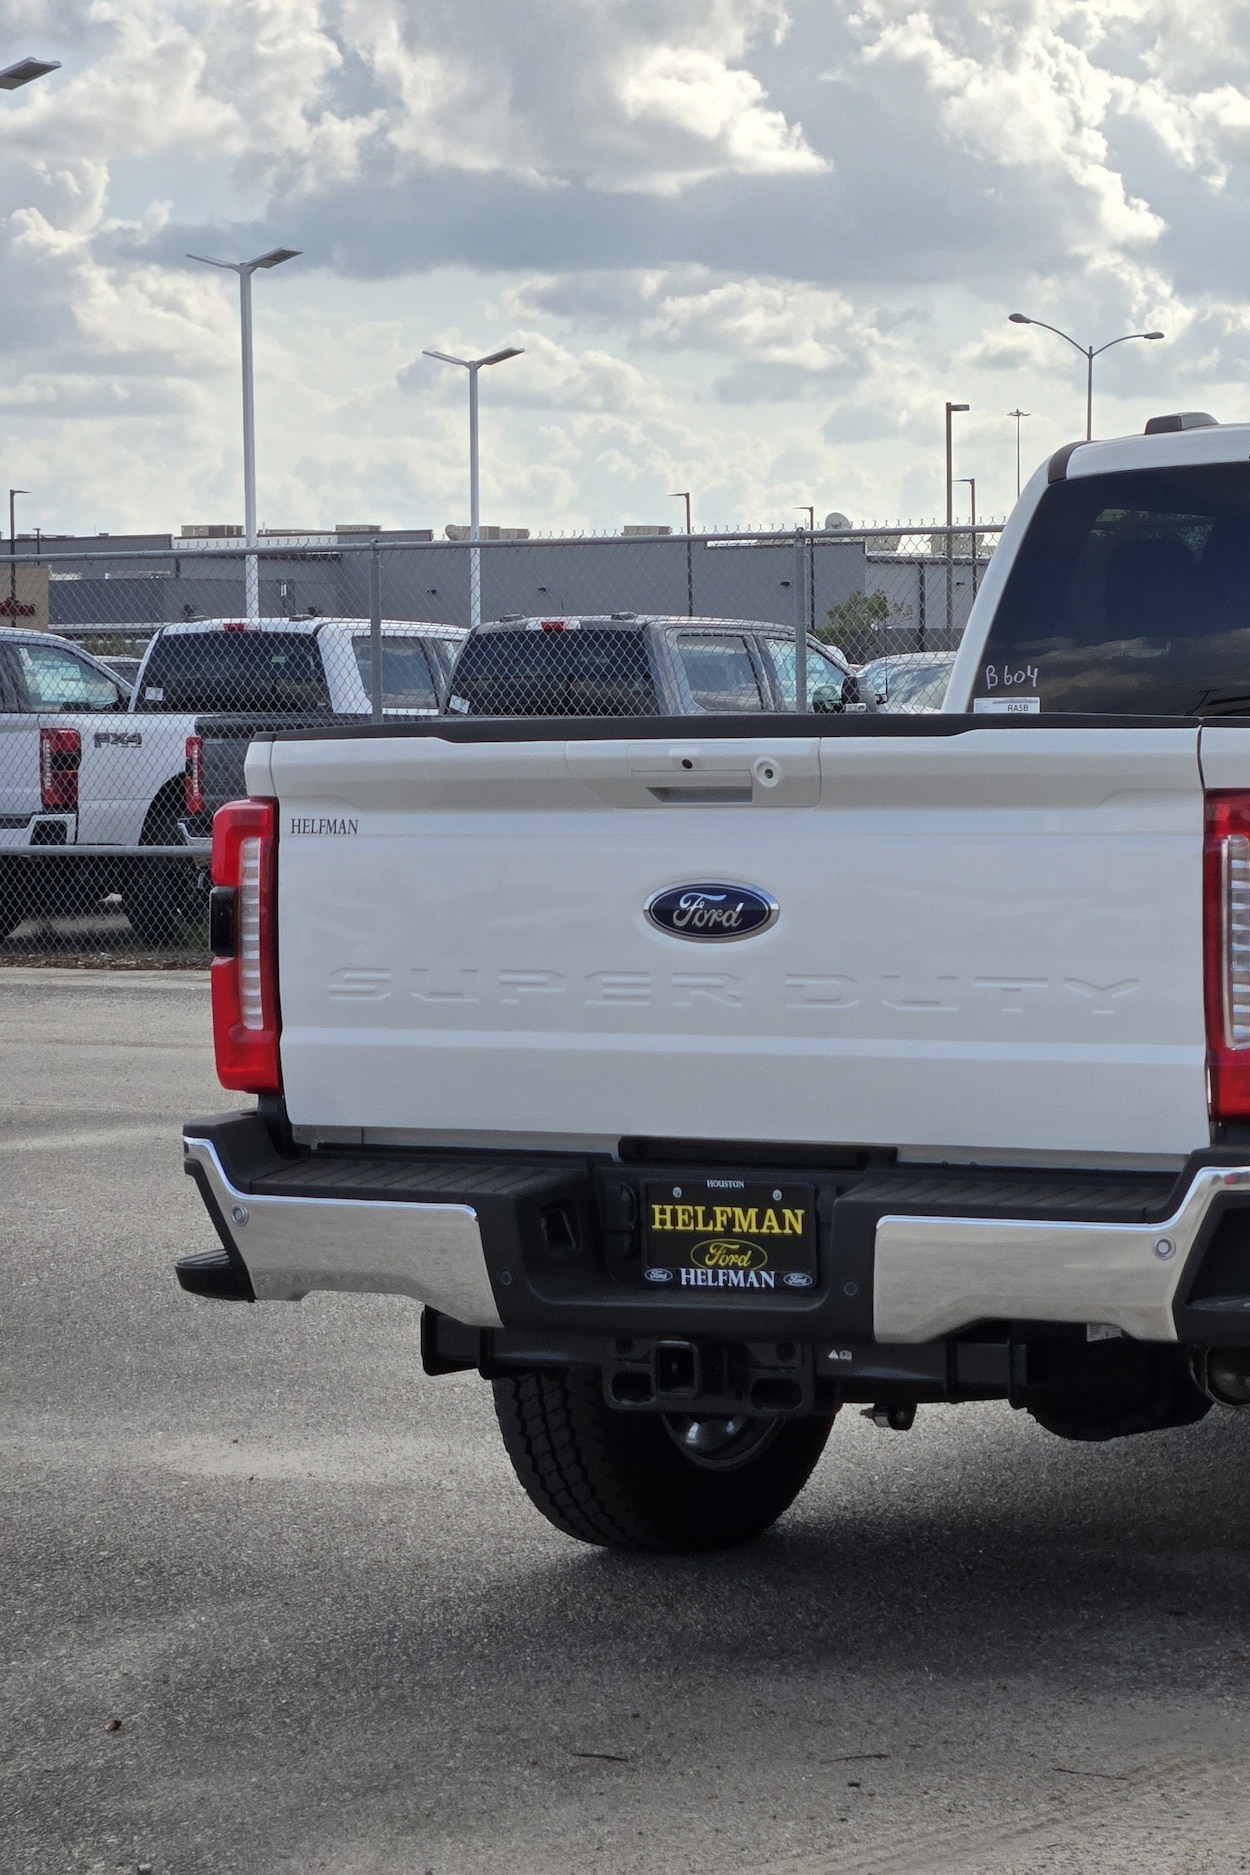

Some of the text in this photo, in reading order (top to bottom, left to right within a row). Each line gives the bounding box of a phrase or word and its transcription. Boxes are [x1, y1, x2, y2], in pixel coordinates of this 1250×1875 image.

[94, 732, 142, 748] FX4
[290, 818, 359, 835] HELFMAN
[672, 892, 745, 928] Ford
[327, 966, 1141, 1015] SUPER DUTY
[706, 1179, 745, 1189] HOUSTON
[651, 1204, 805, 1235] HELFMAN
[704, 1242, 752, 1267] Ford
[679, 1267, 776, 1289] HELFMAN
